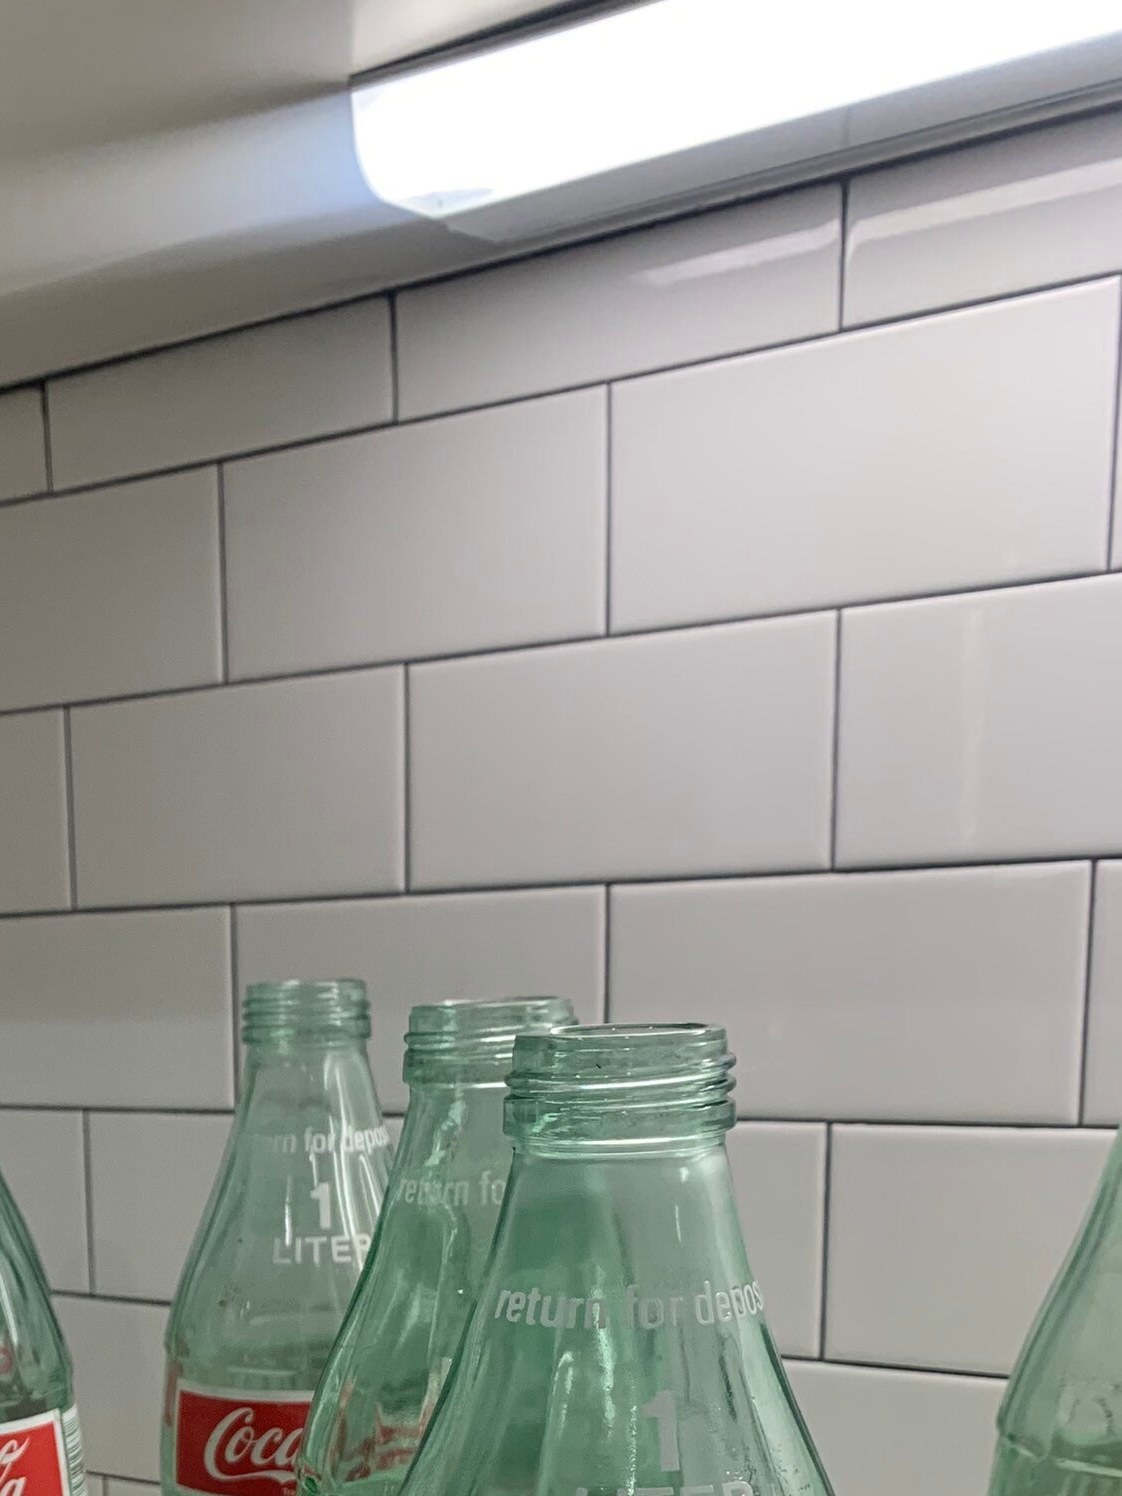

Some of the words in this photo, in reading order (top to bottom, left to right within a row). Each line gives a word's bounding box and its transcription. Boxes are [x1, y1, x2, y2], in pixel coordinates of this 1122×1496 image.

[305, 1126, 335, 1152] for
[310, 1182, 333, 1230] 1
[479, 1170, 506, 1206] fo
[494, 1287, 606, 1330] return
[694, 1280, 765, 1326] depos
[640, 1389, 680, 1472] 1
